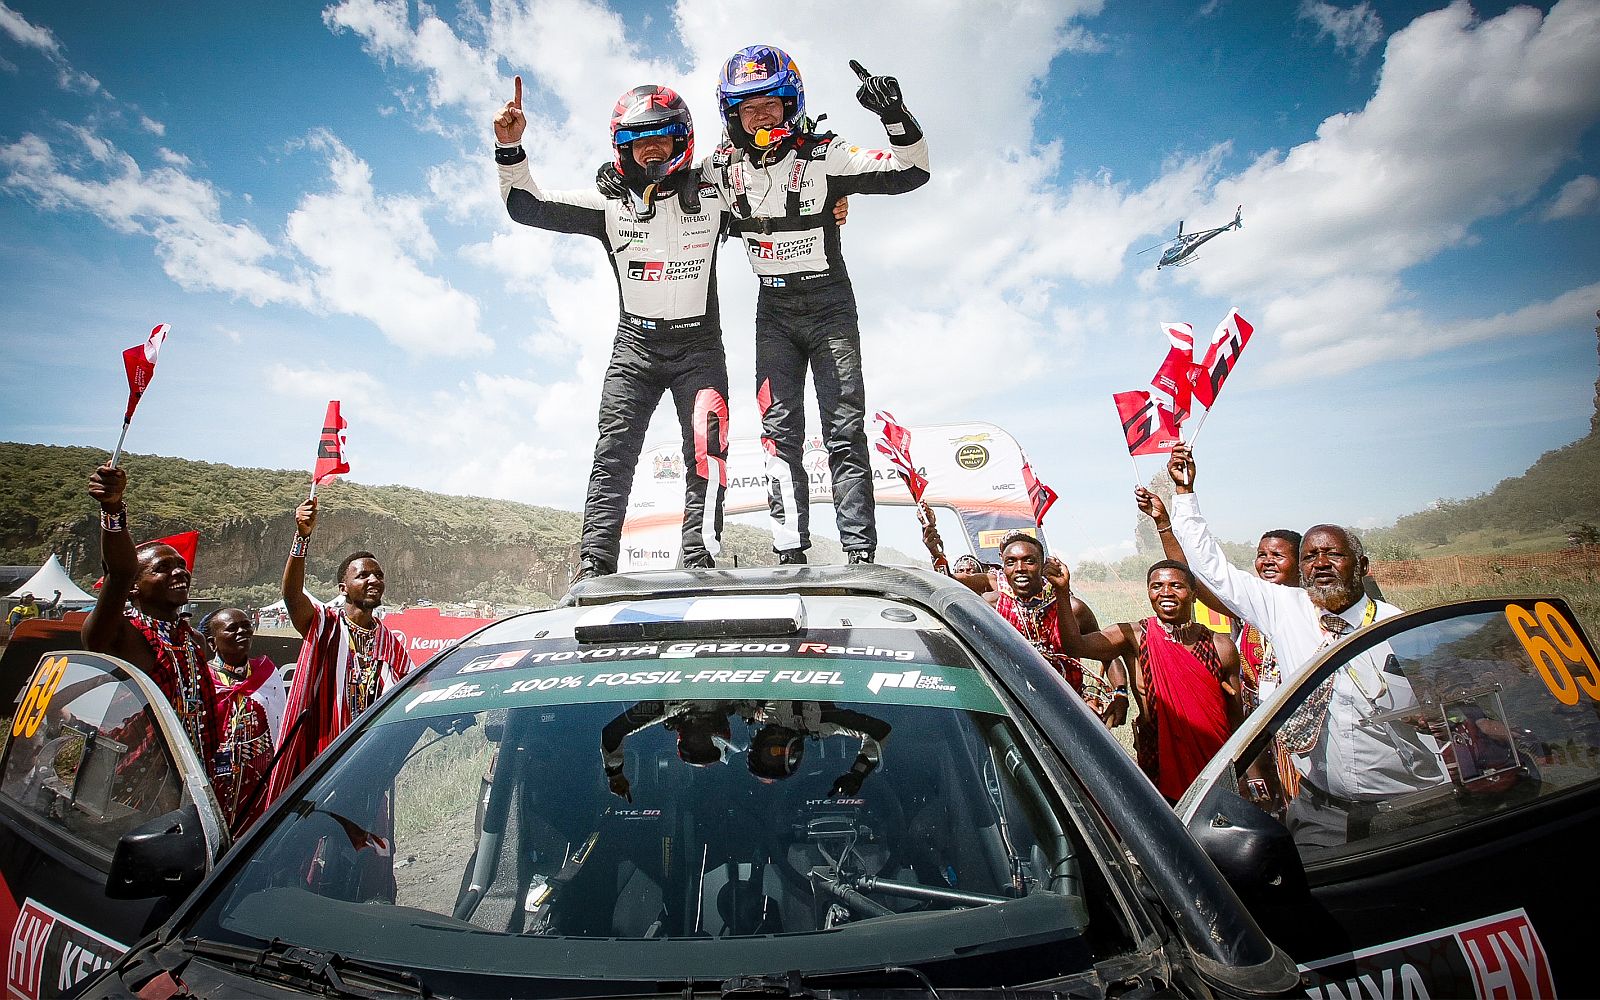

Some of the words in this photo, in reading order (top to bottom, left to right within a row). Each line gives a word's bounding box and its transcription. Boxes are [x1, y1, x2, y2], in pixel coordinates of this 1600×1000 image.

[751, 71, 768, 80] Bull
[811, 145, 827, 157] OMP
[791, 160, 803, 190] SIMPSON
[618, 229, 650, 239] UNIBET
[776, 236, 817, 249] TOYOTA
[776, 242, 813, 256] GAZOO
[776, 248, 812, 261] Racing
[669, 259, 705, 267] TOYOTA
[664, 272, 699, 281] Racing
[665, 265, 702, 275] GAZOO
[531, 646, 659, 664] TOYOTA
[659, 642, 790, 659] GAZOO
[798, 642, 915, 660] Racing
[1505, 601, 1600, 706] 69
[503, 675, 585, 694] 100%
[587, 670, 771, 688] FOSSIL-FREE
[770, 670, 845, 685] FUEL
[13, 656, 68, 738] 69
[11, 911, 51, 992] HY
[1466, 925, 1541, 1000] HY
